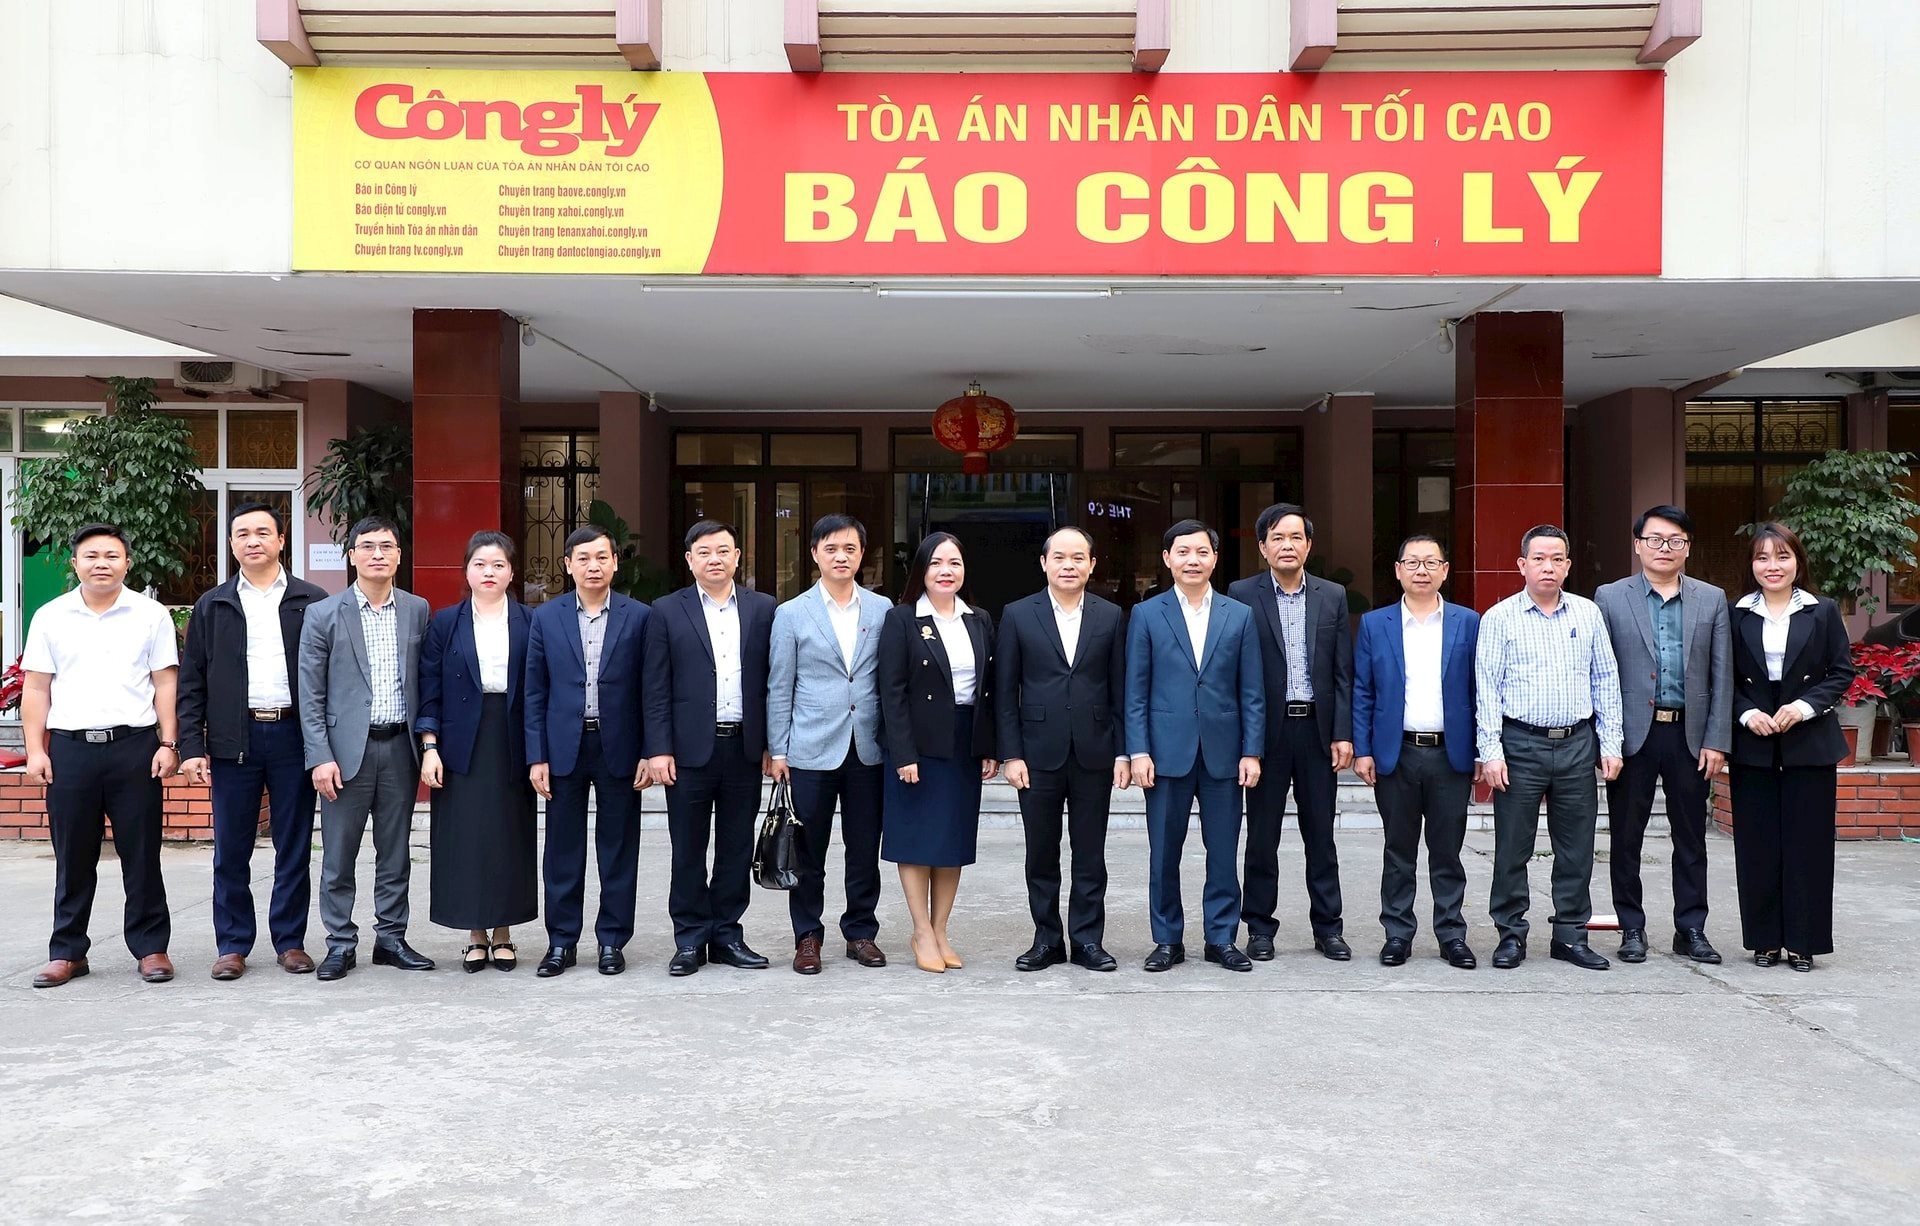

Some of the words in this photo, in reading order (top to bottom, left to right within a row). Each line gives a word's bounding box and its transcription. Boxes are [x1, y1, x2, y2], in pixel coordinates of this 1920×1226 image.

[838, 95, 940, 142] TÒA
[957, 95, 1026, 141] ÁN
[1050, 95, 1193, 141] NHÂN
[1216, 95, 1321, 141] DÂN
[1342, 89, 1424, 141] TỐI
[1447, 102, 1551, 141] CAO
[355, 160, 371, 169] CƠ
[375, 161, 405, 169] QUAN
[409, 159, 440, 170] NGÔN
[477, 160, 499, 171] CỦA
[546, 161, 576, 171] NHÂN
[580, 161, 602, 171] DÂN
[626, 163, 649, 172] CAO
[355, 183, 372, 195] Báo
[375, 183, 382, 195] in
[385, 183, 407, 196] Công
[410, 184, 417, 197] lý
[499, 185, 530, 198] Chuyên
[533, 185, 555, 198] trang
[558, 185, 626, 199] baove.congly.vn
[785, 157, 1027, 243] BÁO
[1076, 157, 1413, 243] CÔNG
[1463, 156, 1602, 242] LÝ
[356, 203, 372, 215] Báo
[374, 203, 393, 217] điện
[407, 204, 446, 217] congly.vn
[499, 204, 530, 218] Chuyên
[533, 205, 555, 218] trang
[558, 205, 624, 219] xahoi.congly.vn
[355, 222, 384, 236] Truyền
[386, 224, 405, 235] hình
[408, 224, 423, 235] Tòa
[426, 224, 436, 235] án
[439, 224, 459, 236] nhân
[462, 224, 478, 236] dân
[499, 225, 530, 238] Chuyên
[533, 226, 554, 238] trang
[557, 226, 648, 239] tenanxahoi.congly.vn
[355, 243, 386, 256] Chuyên
[389, 244, 411, 257] trang
[414, 244, 463, 257] tv.congly.vn
[498, 245, 529, 258] Chuyên
[532, 245, 554, 258] trang
[557, 246, 661, 259] dantoctongiao.congly.vn
